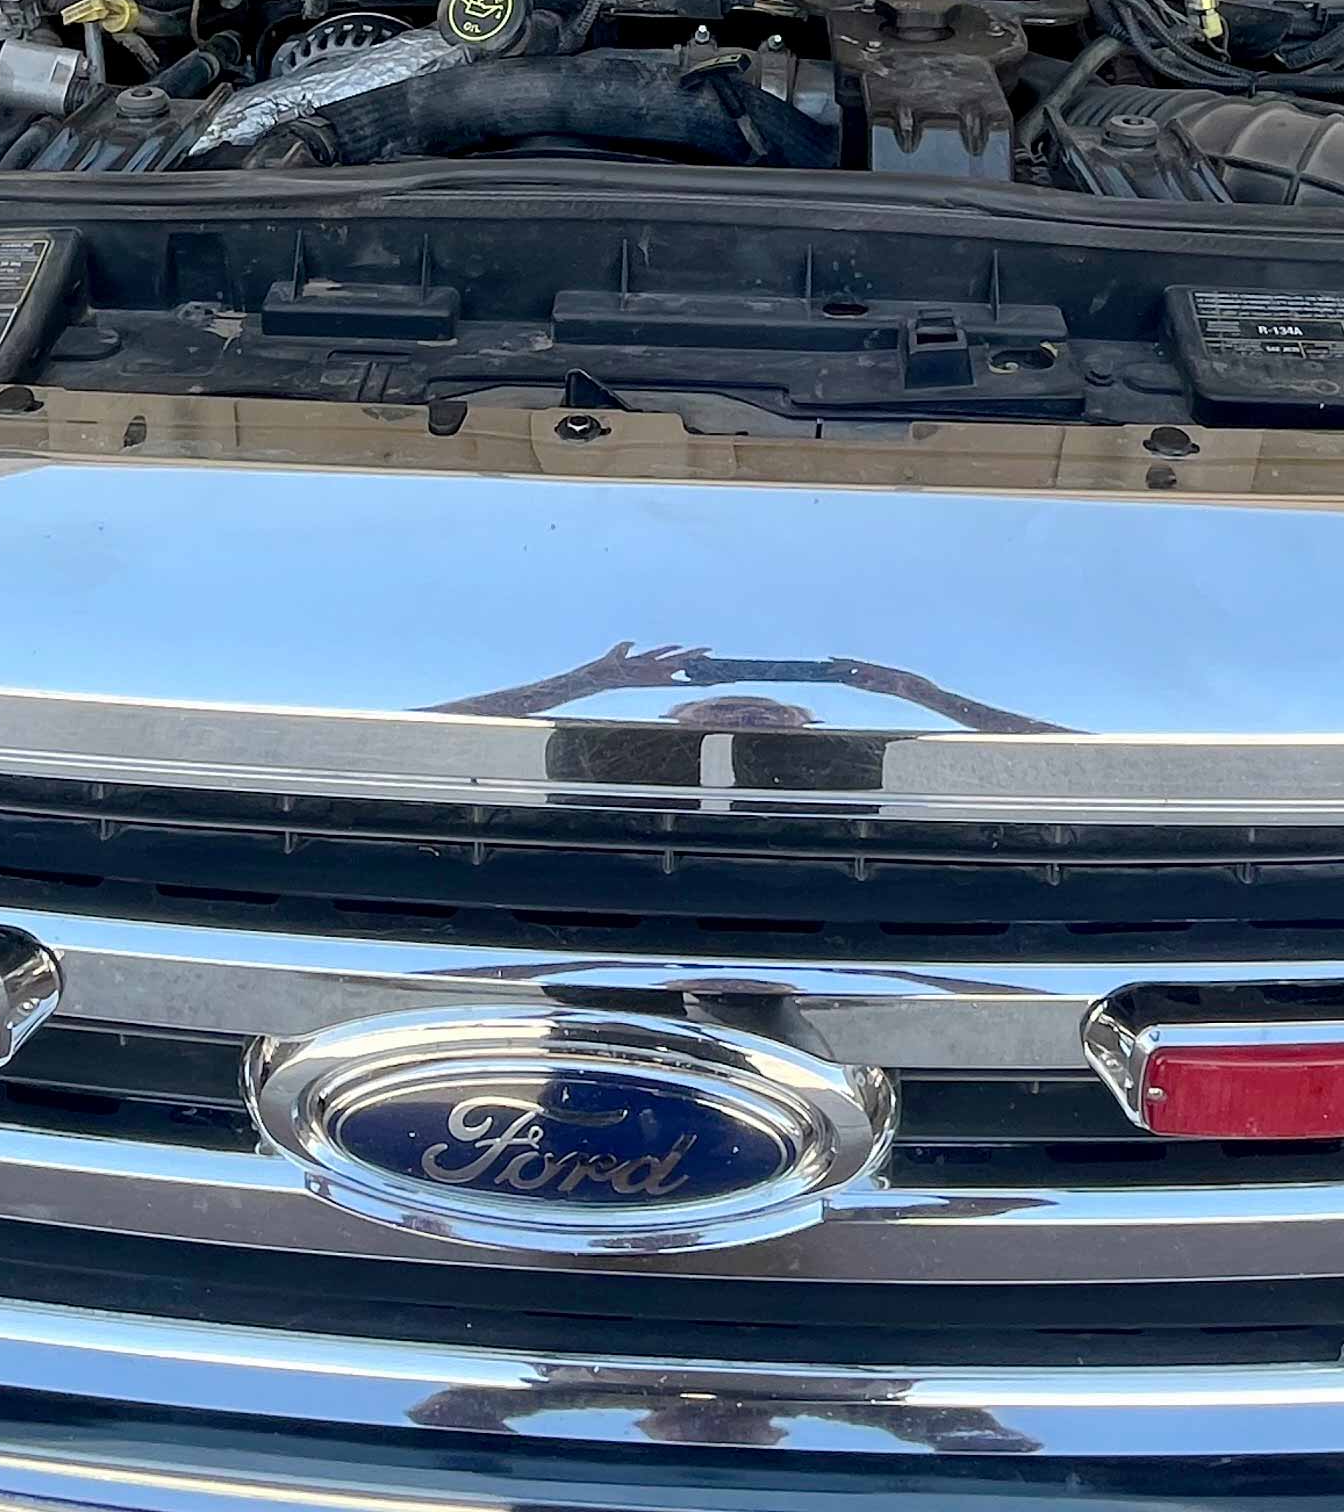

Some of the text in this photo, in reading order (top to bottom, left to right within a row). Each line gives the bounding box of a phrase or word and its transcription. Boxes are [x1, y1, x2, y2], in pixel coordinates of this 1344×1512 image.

[463, 21, 482, 34] OIL
[1258, 325, 1304, 337] R-134A
[421, 1095, 698, 1195] Ford
